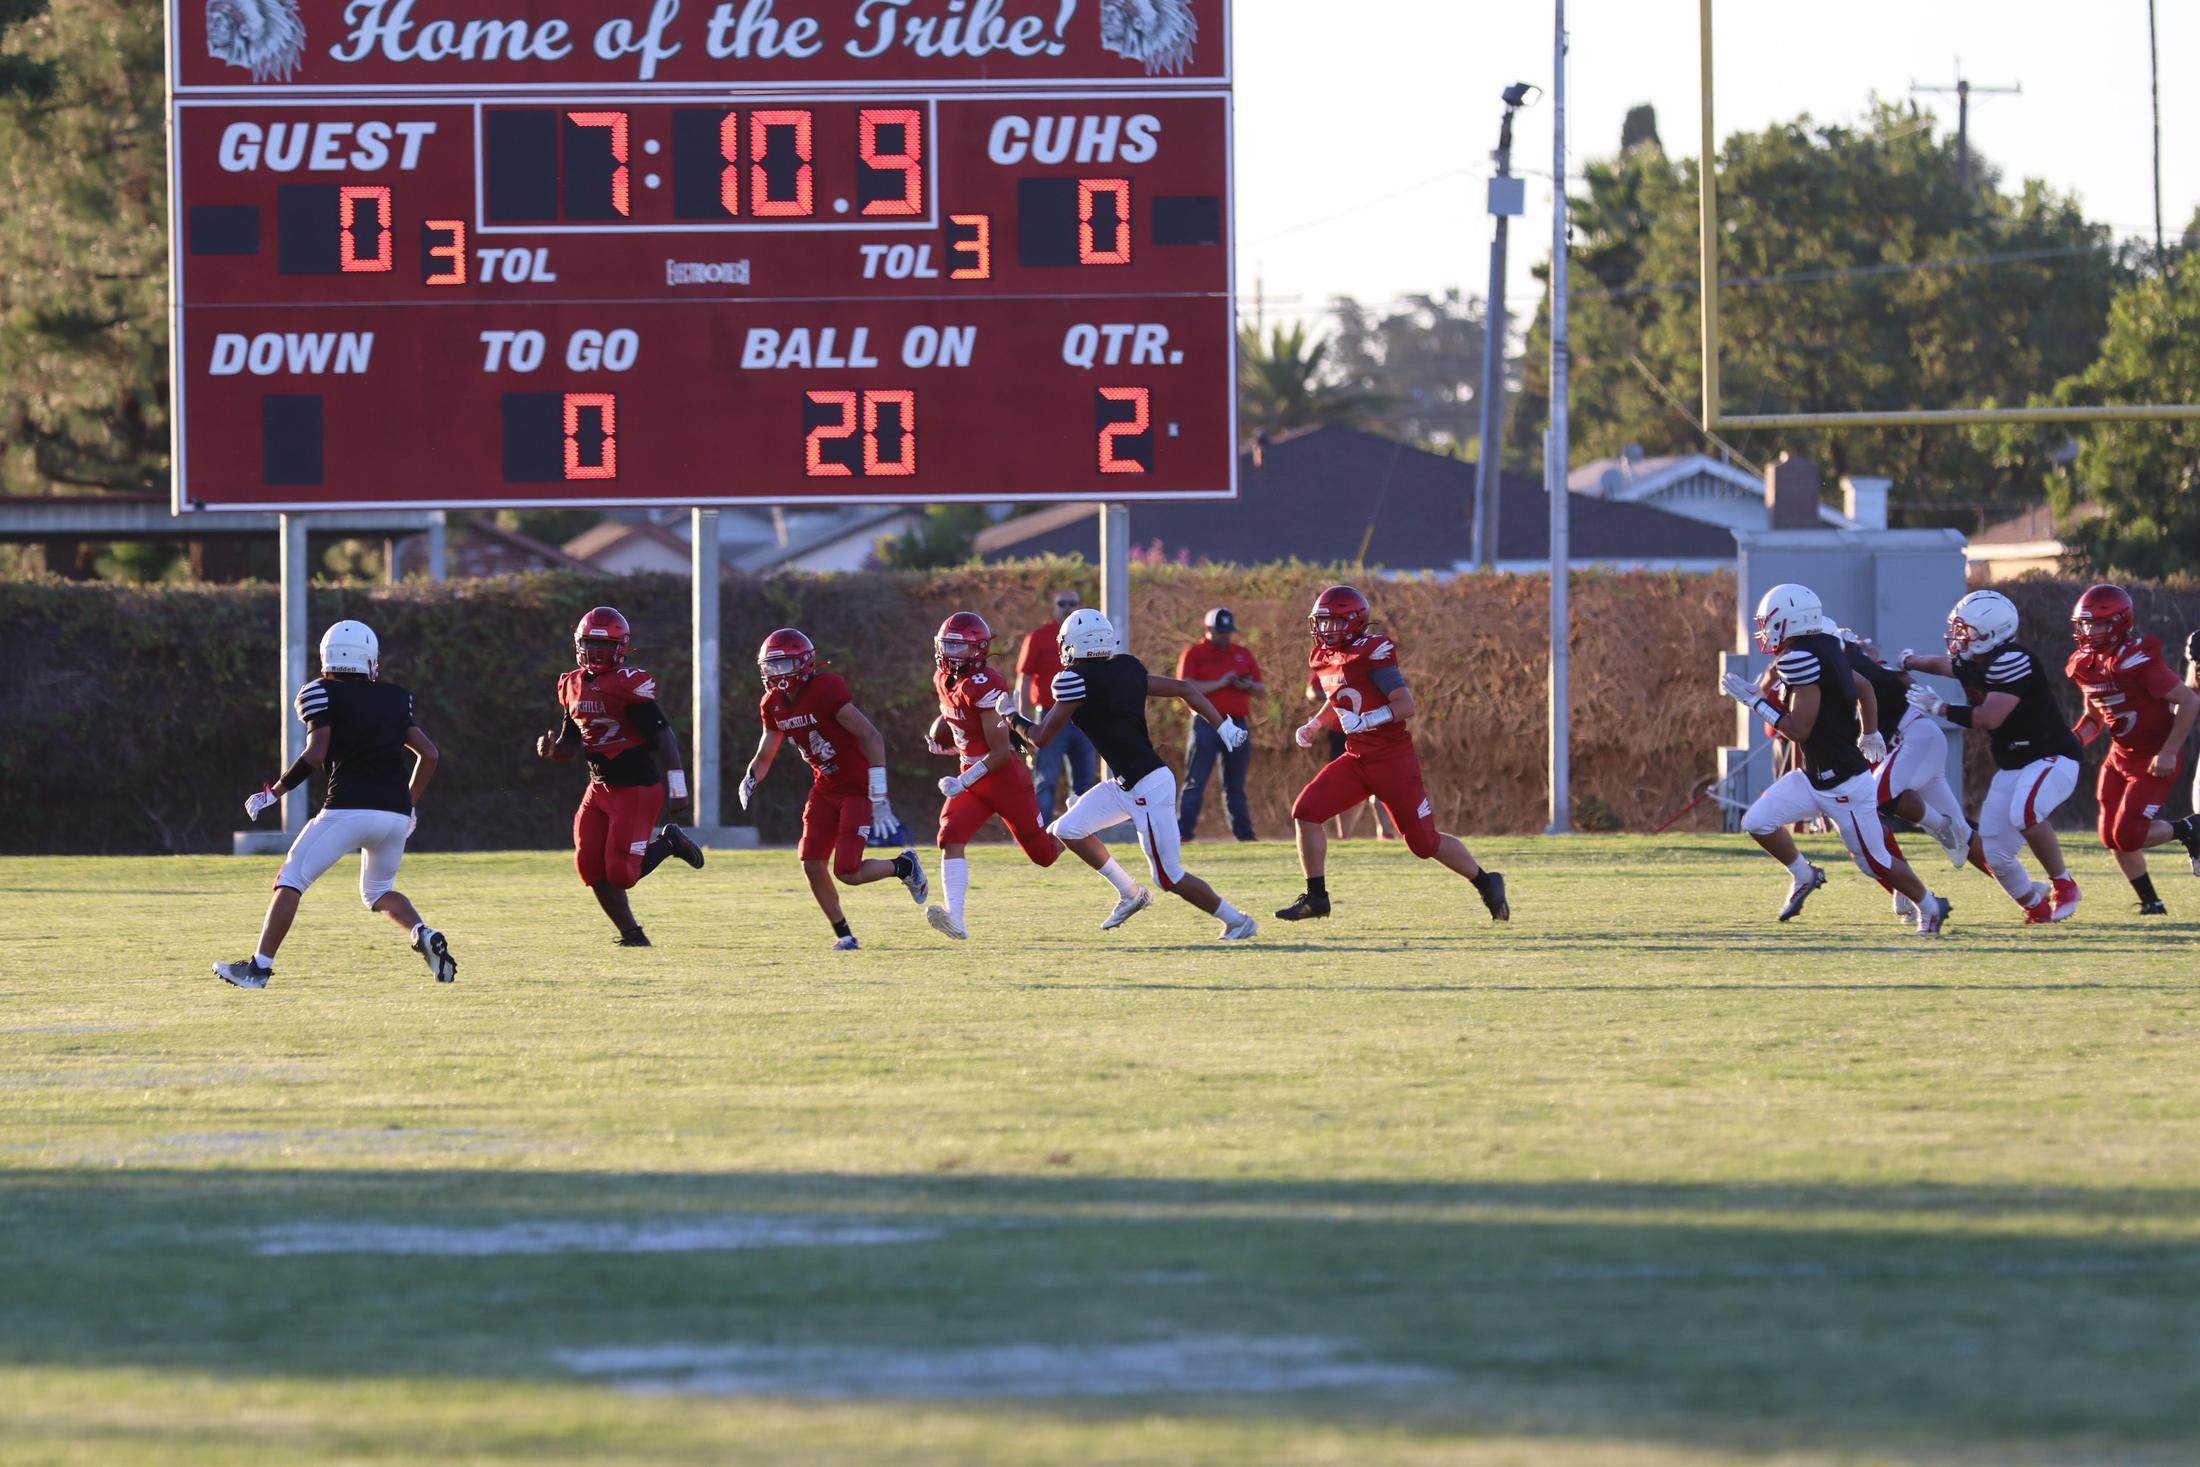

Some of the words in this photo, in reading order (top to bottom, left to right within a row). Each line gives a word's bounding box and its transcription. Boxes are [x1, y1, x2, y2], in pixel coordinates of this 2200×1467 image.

[329, 0, 573, 62] Home
[593, 0, 681, 80] of
[706, 0, 823, 59] the
[844, 0, 1077, 58] Tribe!
[218, 121, 437, 172] GUEST
[988, 114, 1161, 165] CUHS
[340, 186, 393, 272] 0
[425, 219, 467, 285] 3
[476, 247, 556, 283] TOL
[860, 244, 939, 279] TOL
[949, 214, 990, 280] 3
[1078, 178, 1131, 265] 0
[209, 332, 374, 376] DOWN
[480, 329, 546, 373] TO
[566, 328, 639, 372] GO
[741, 327, 878, 369] BALL
[902, 325, 977, 368] ON
[1062, 323, 1184, 370] QTR.
[564, 392, 617, 480] 0
[805, 389, 916, 476] 20
[1098, 386, 1150, 473] 2
[971, 673, 989, 684] 8
